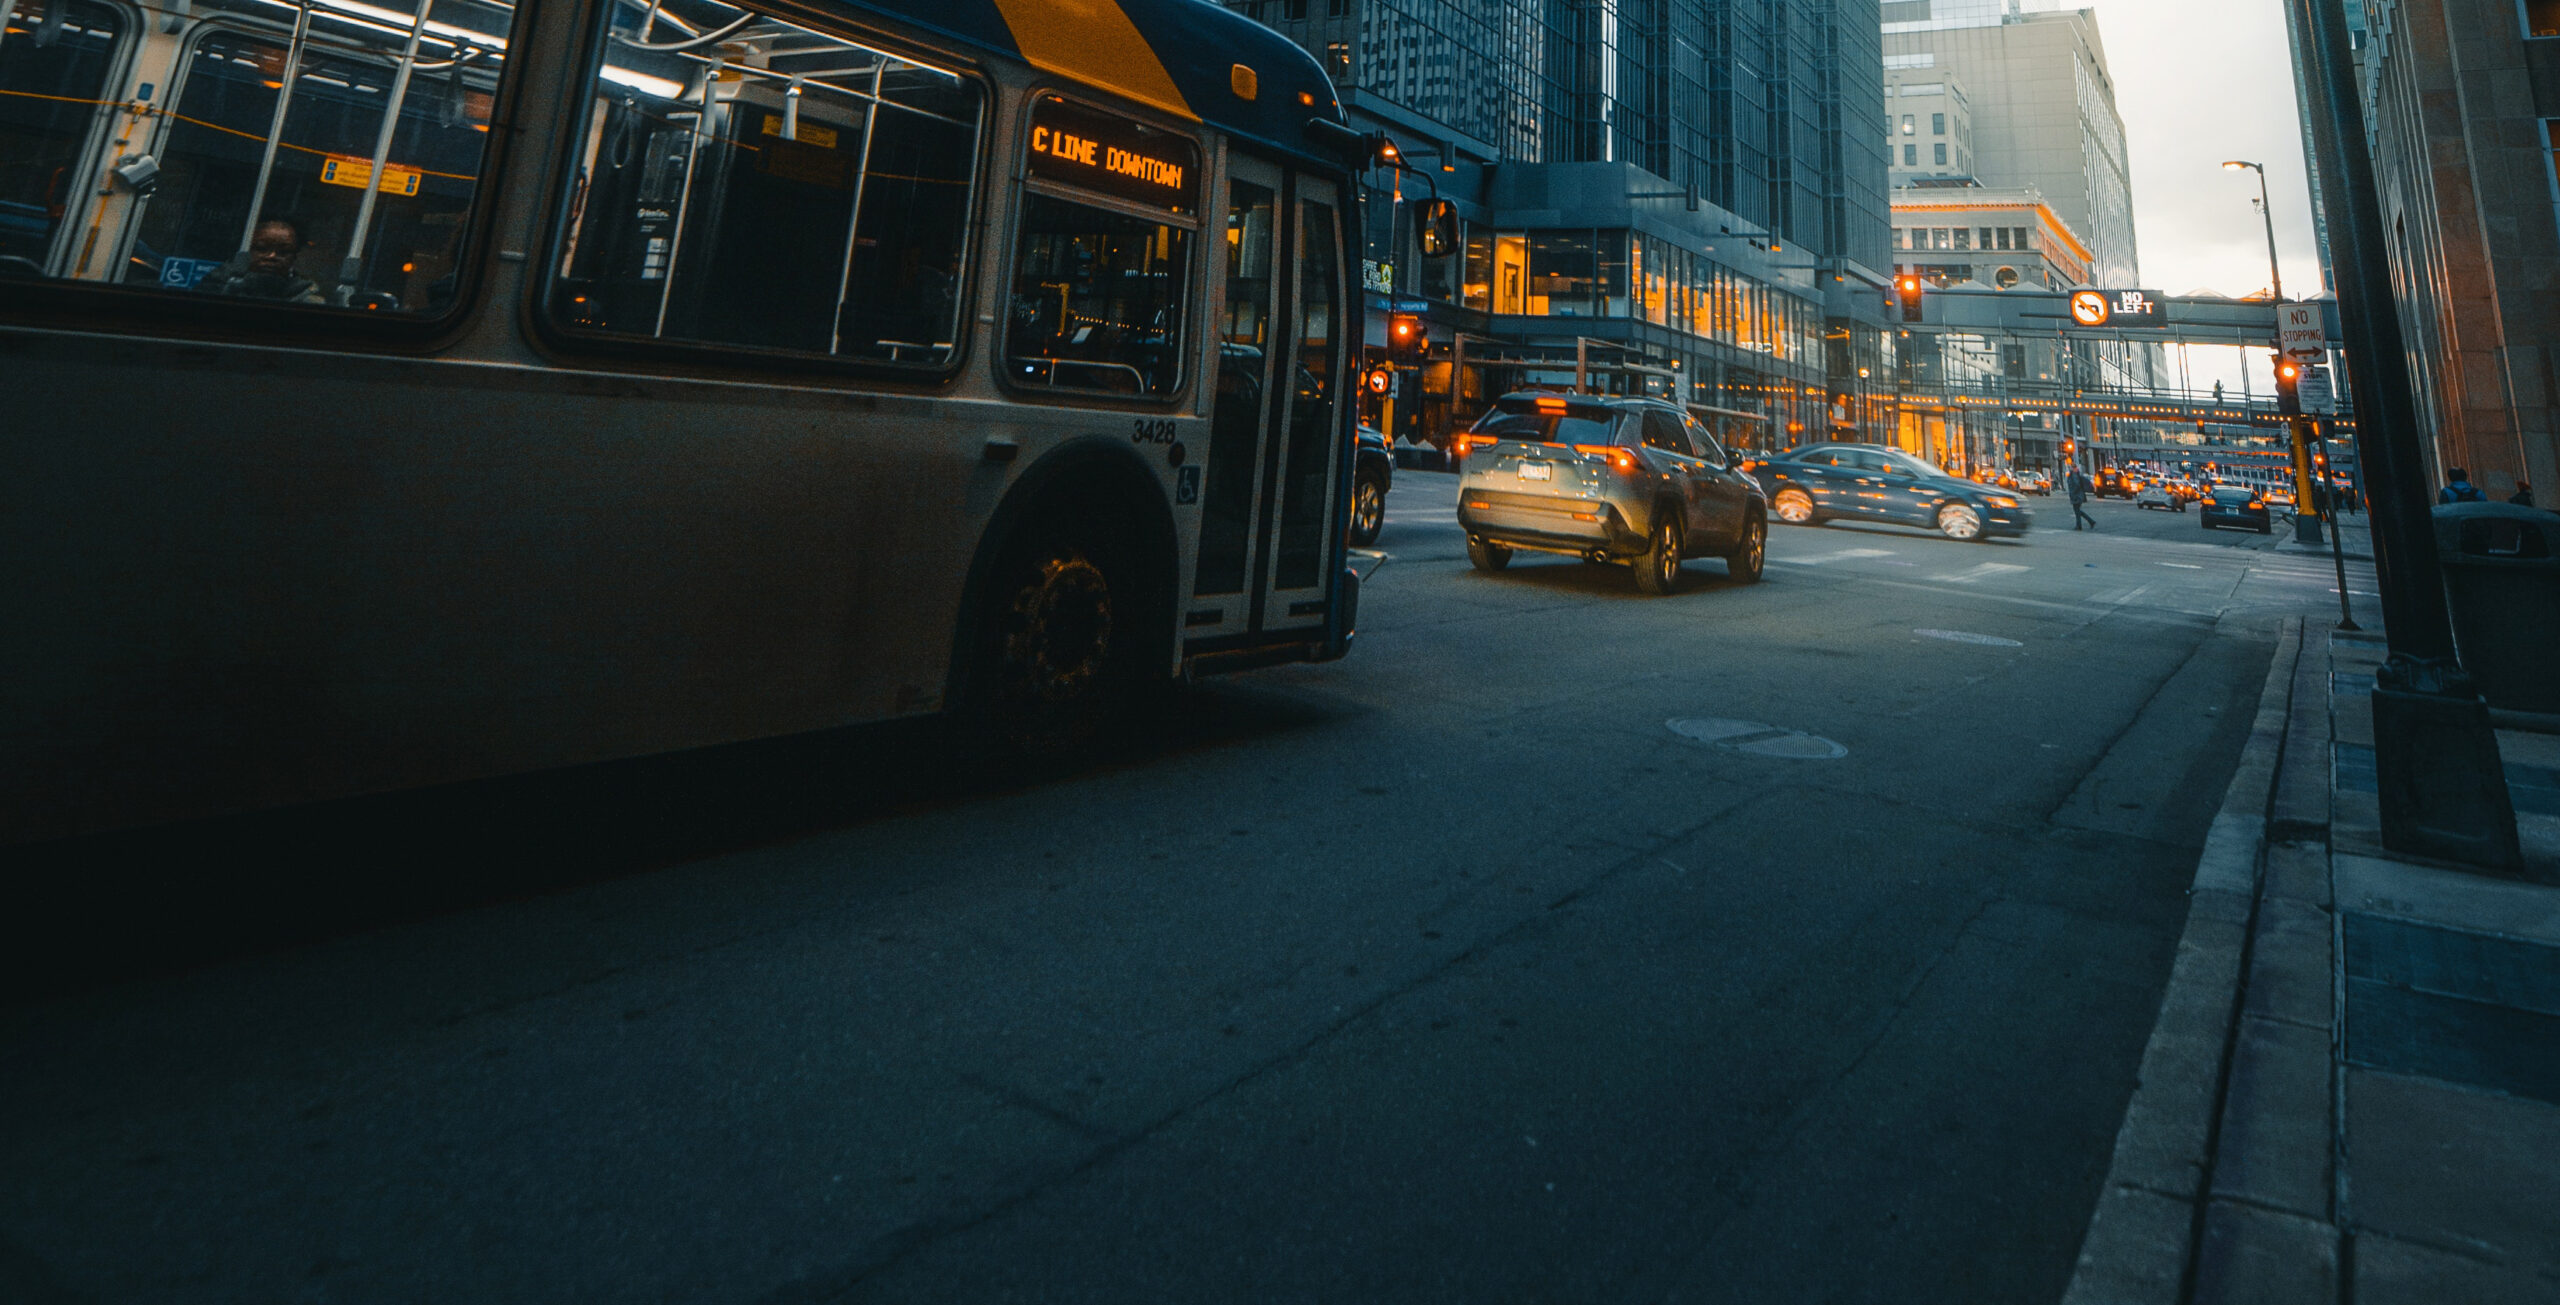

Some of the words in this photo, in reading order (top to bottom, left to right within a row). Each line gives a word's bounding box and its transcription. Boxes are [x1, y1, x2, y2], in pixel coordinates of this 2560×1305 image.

[1033, 126, 1048, 152] C
[1052, 132, 1097, 166] LINE
[1106, 147, 1182, 189] DOWNTOWN
[2121, 291, 2143, 302] NO
[2112, 301, 2154, 314] LEFT
[2290, 309, 2309, 325] NO
[2283, 328, 2321, 342] STOPPING
[1132, 420, 1176, 444] 3428
